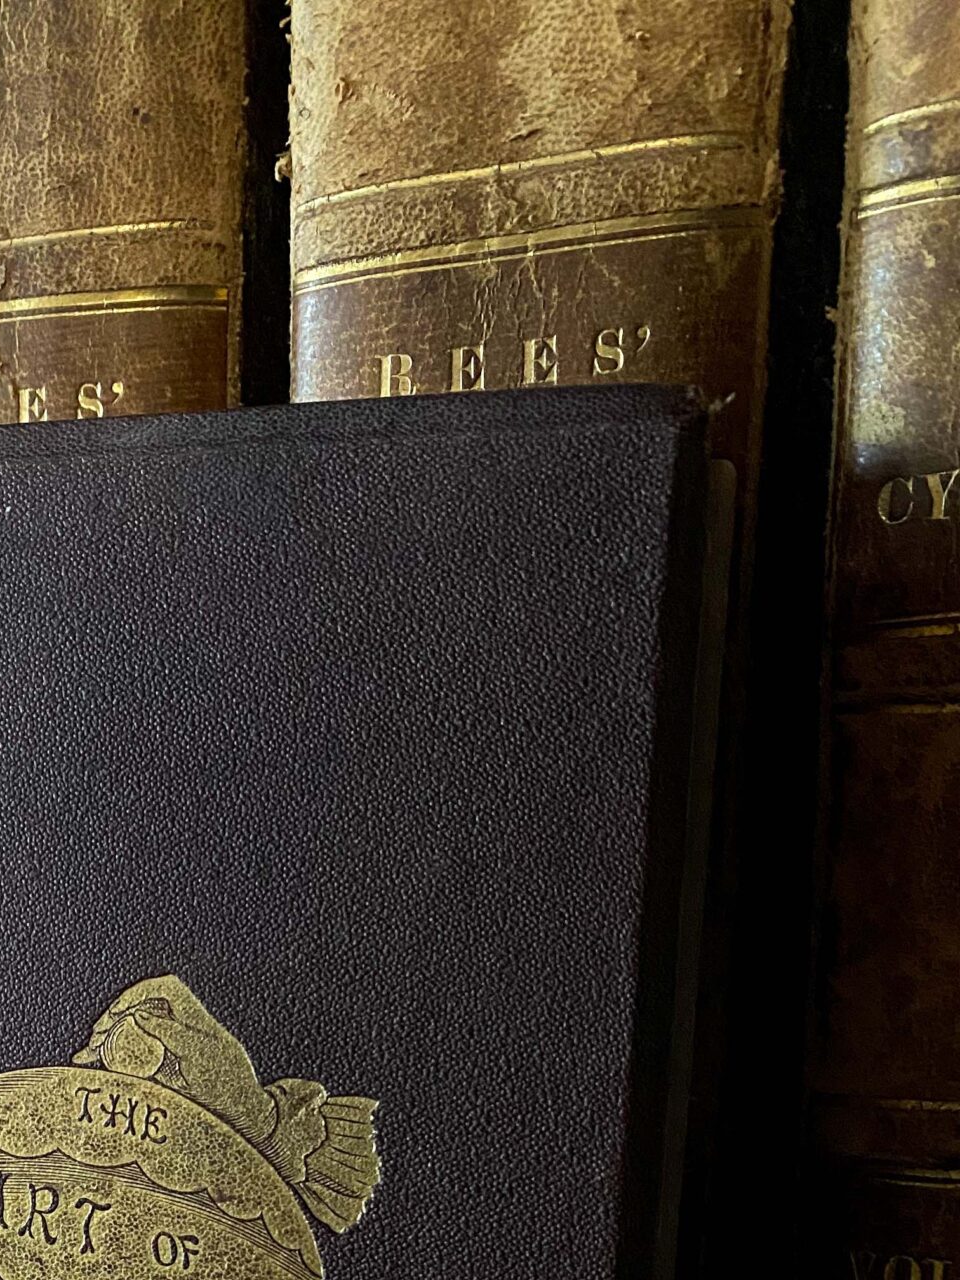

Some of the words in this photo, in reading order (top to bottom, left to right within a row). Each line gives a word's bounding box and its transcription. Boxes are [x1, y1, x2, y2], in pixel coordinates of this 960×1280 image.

[374, 325, 651, 398] REES'
[74, 1086, 168, 1144] THE
[151, 1231, 200, 1270] OF
